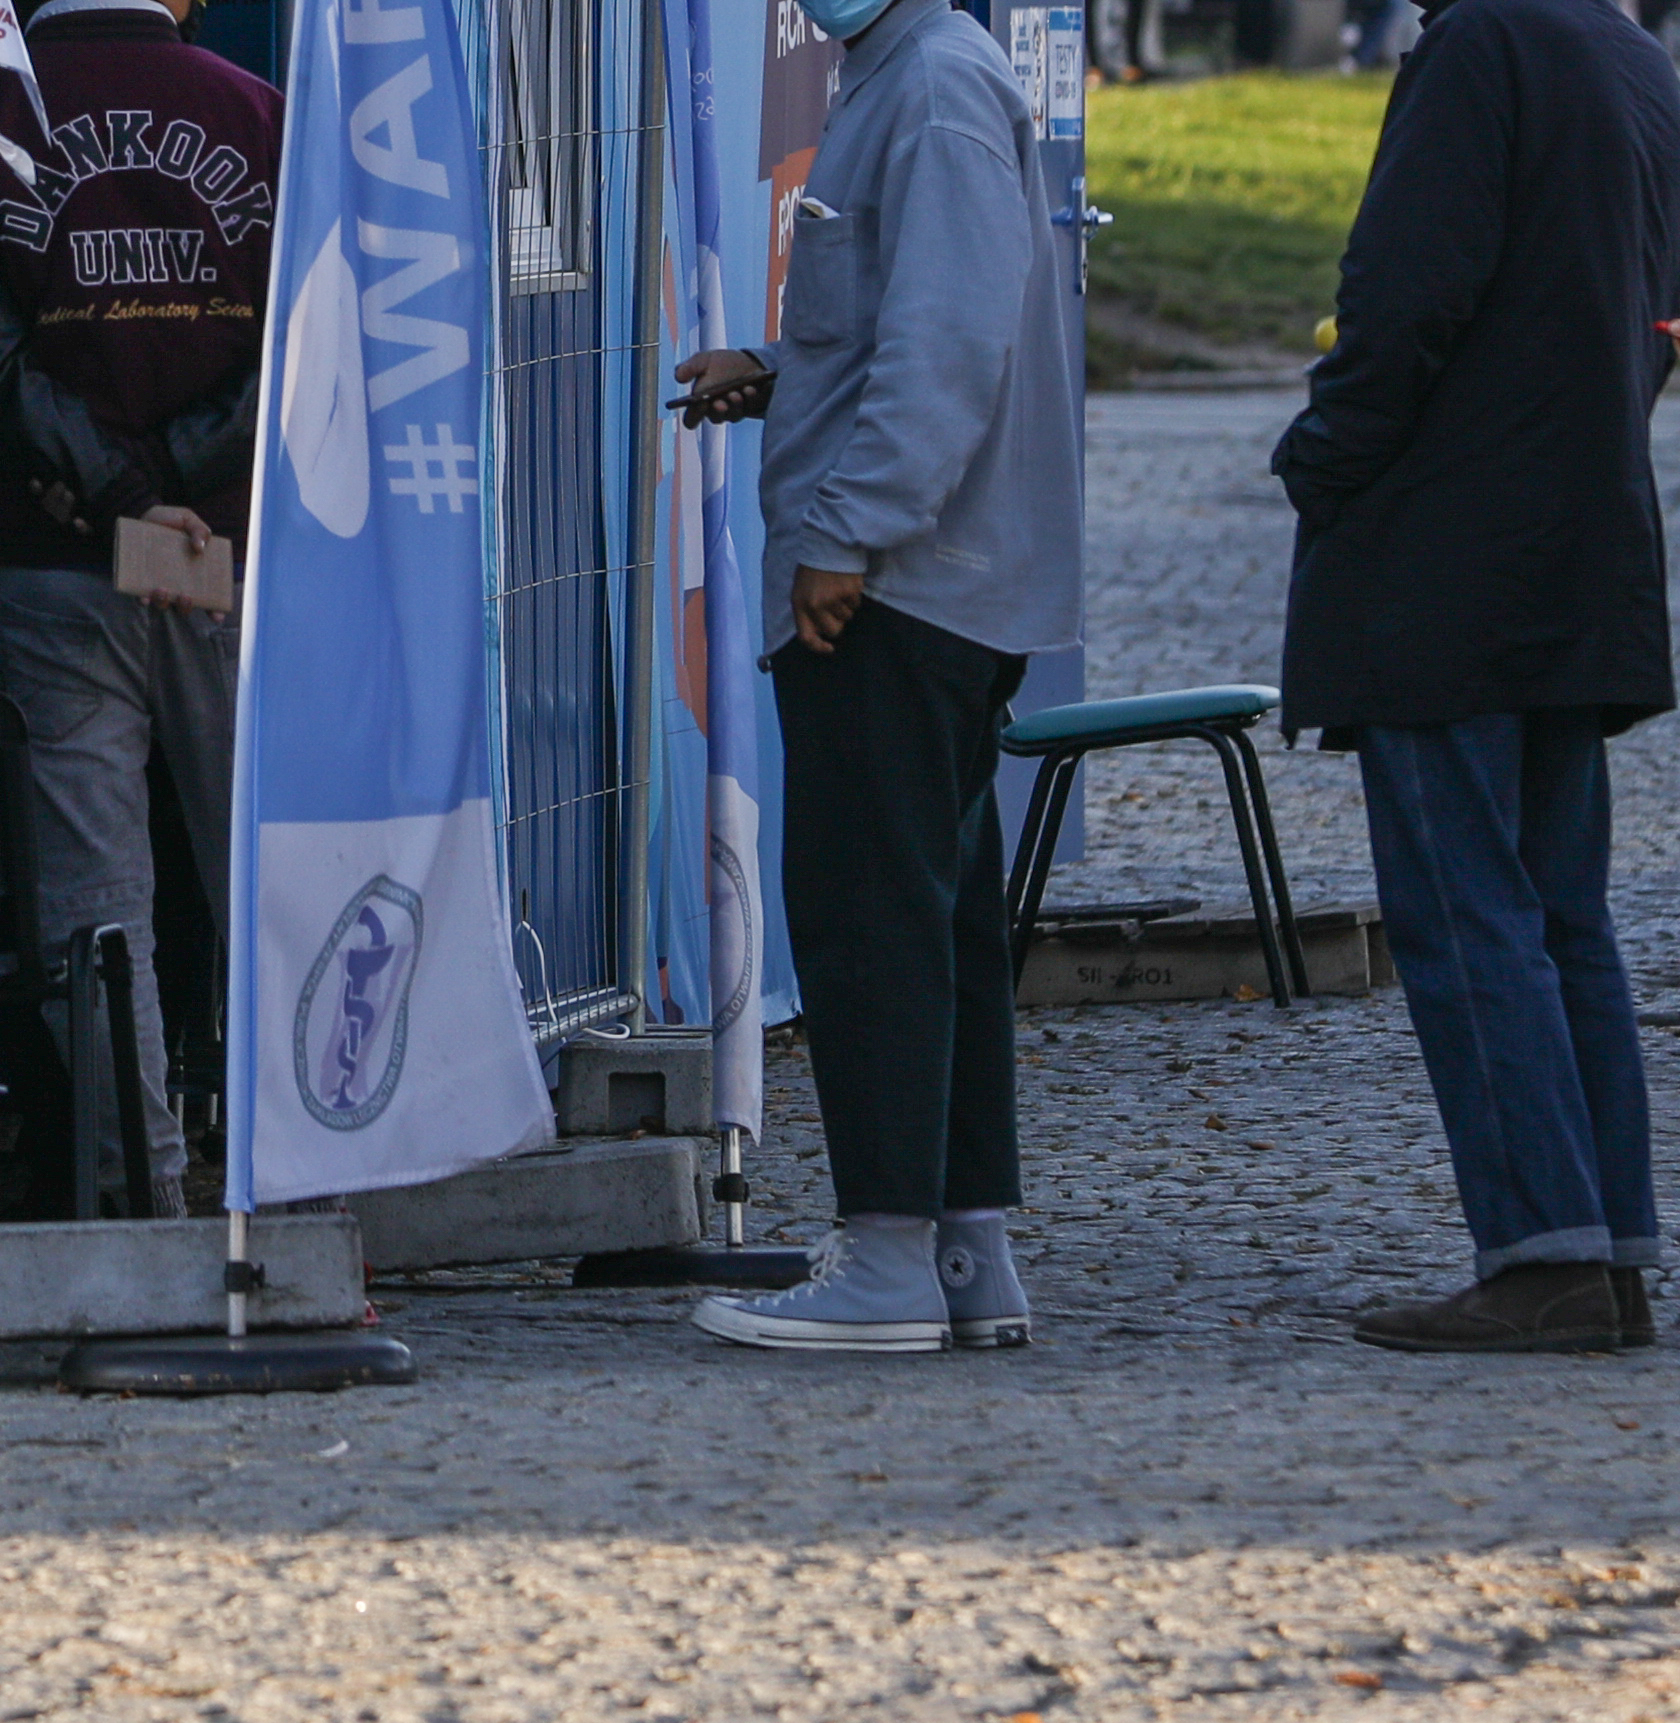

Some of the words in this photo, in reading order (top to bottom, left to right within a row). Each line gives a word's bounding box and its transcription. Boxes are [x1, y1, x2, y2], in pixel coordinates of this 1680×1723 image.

[70, 229, 217, 286] UNIV.
[38, 302, 96, 325] edical
[104, 298, 200, 322] Laboratory
